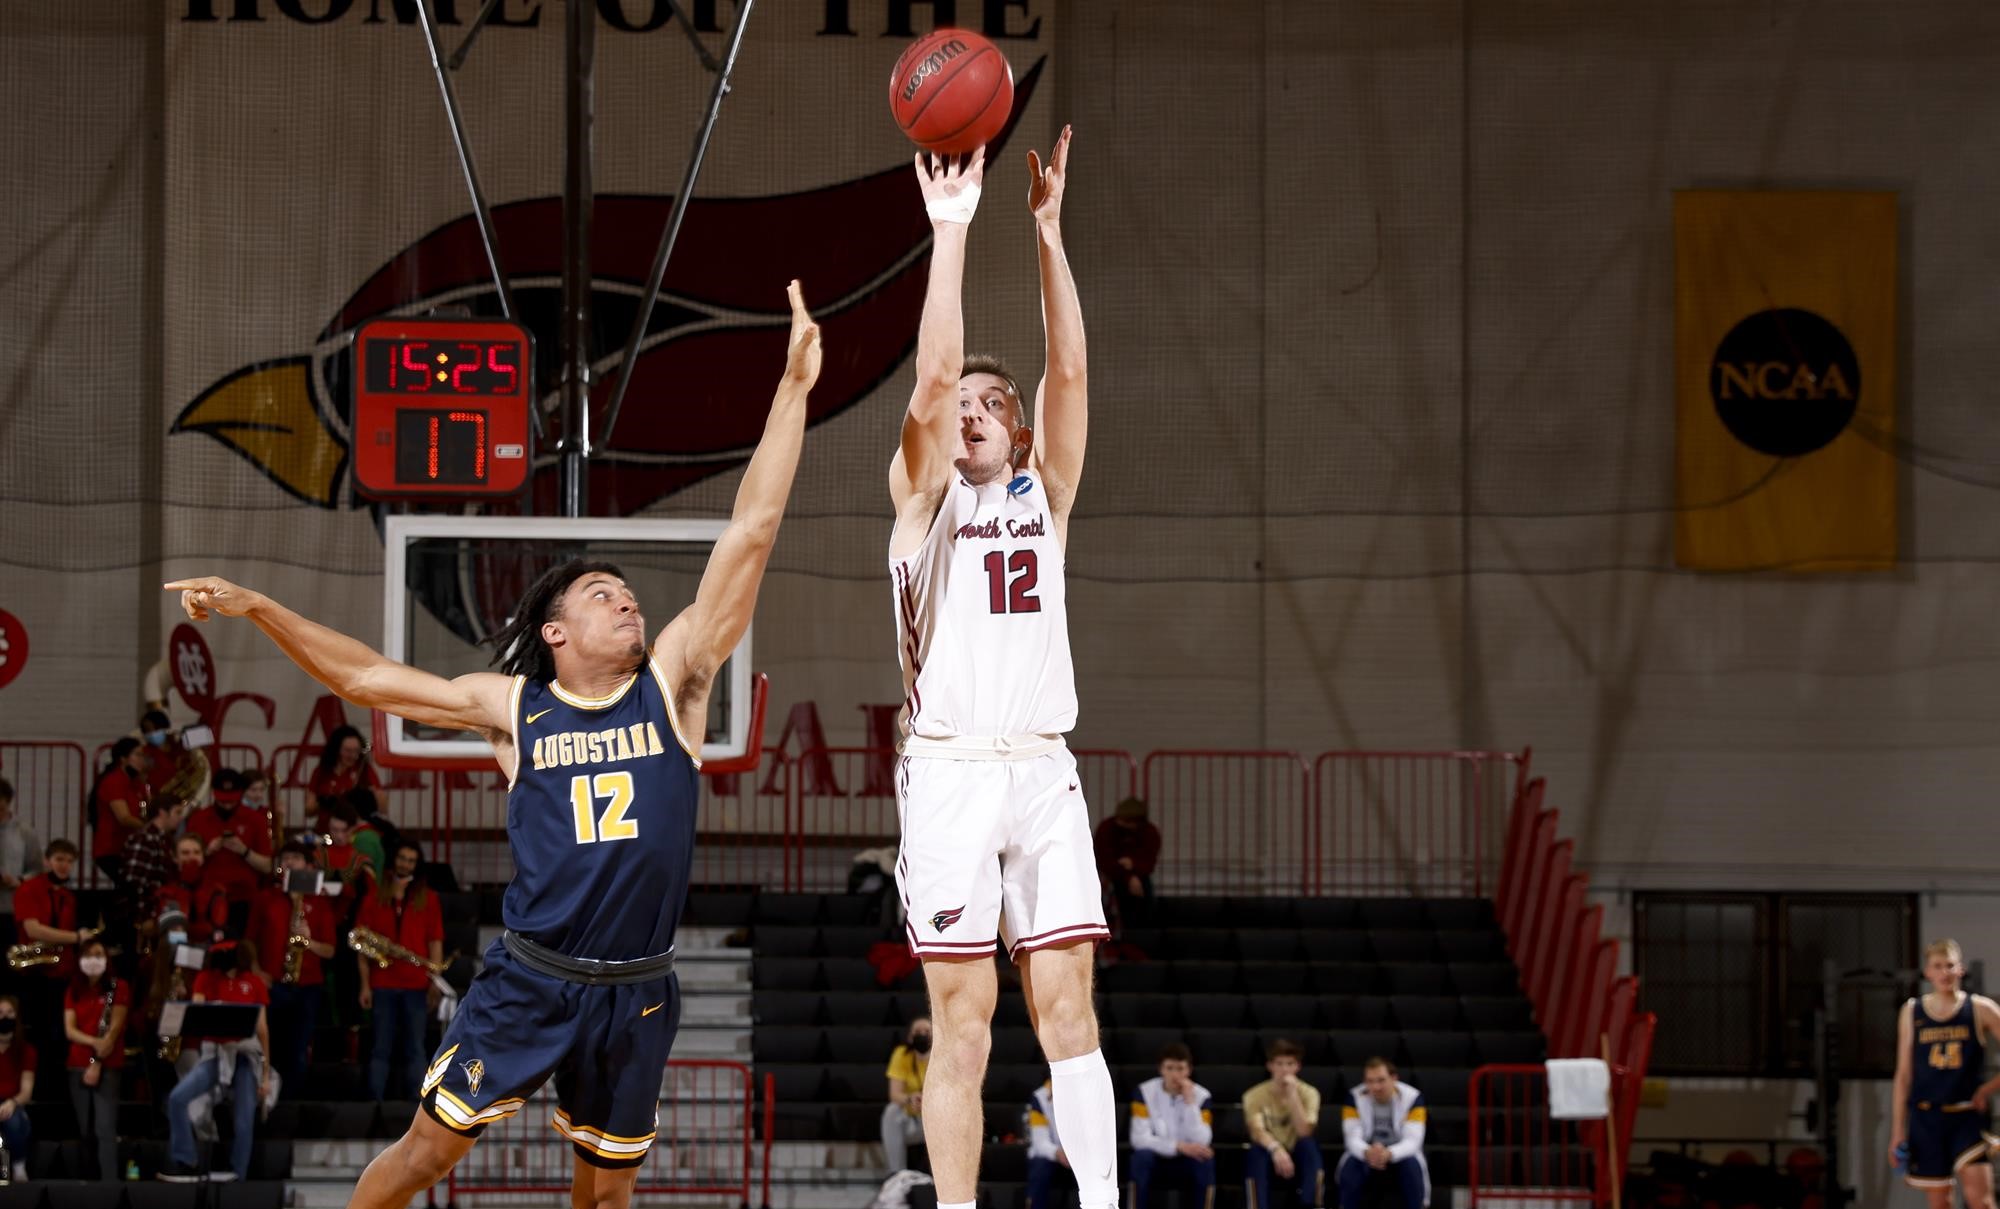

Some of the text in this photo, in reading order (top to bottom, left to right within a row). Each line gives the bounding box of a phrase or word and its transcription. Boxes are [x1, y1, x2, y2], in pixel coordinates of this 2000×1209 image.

[902, 39, 969, 101] Wilson
[389, 342, 518, 393] 15:25
[1716, 360, 1855, 401] NCAA
[428, 413, 486, 479] 17
[984, 549, 1041, 614] 12
[533, 721, 664, 770] AUGUSTANA
[570, 771, 639, 845] 12
